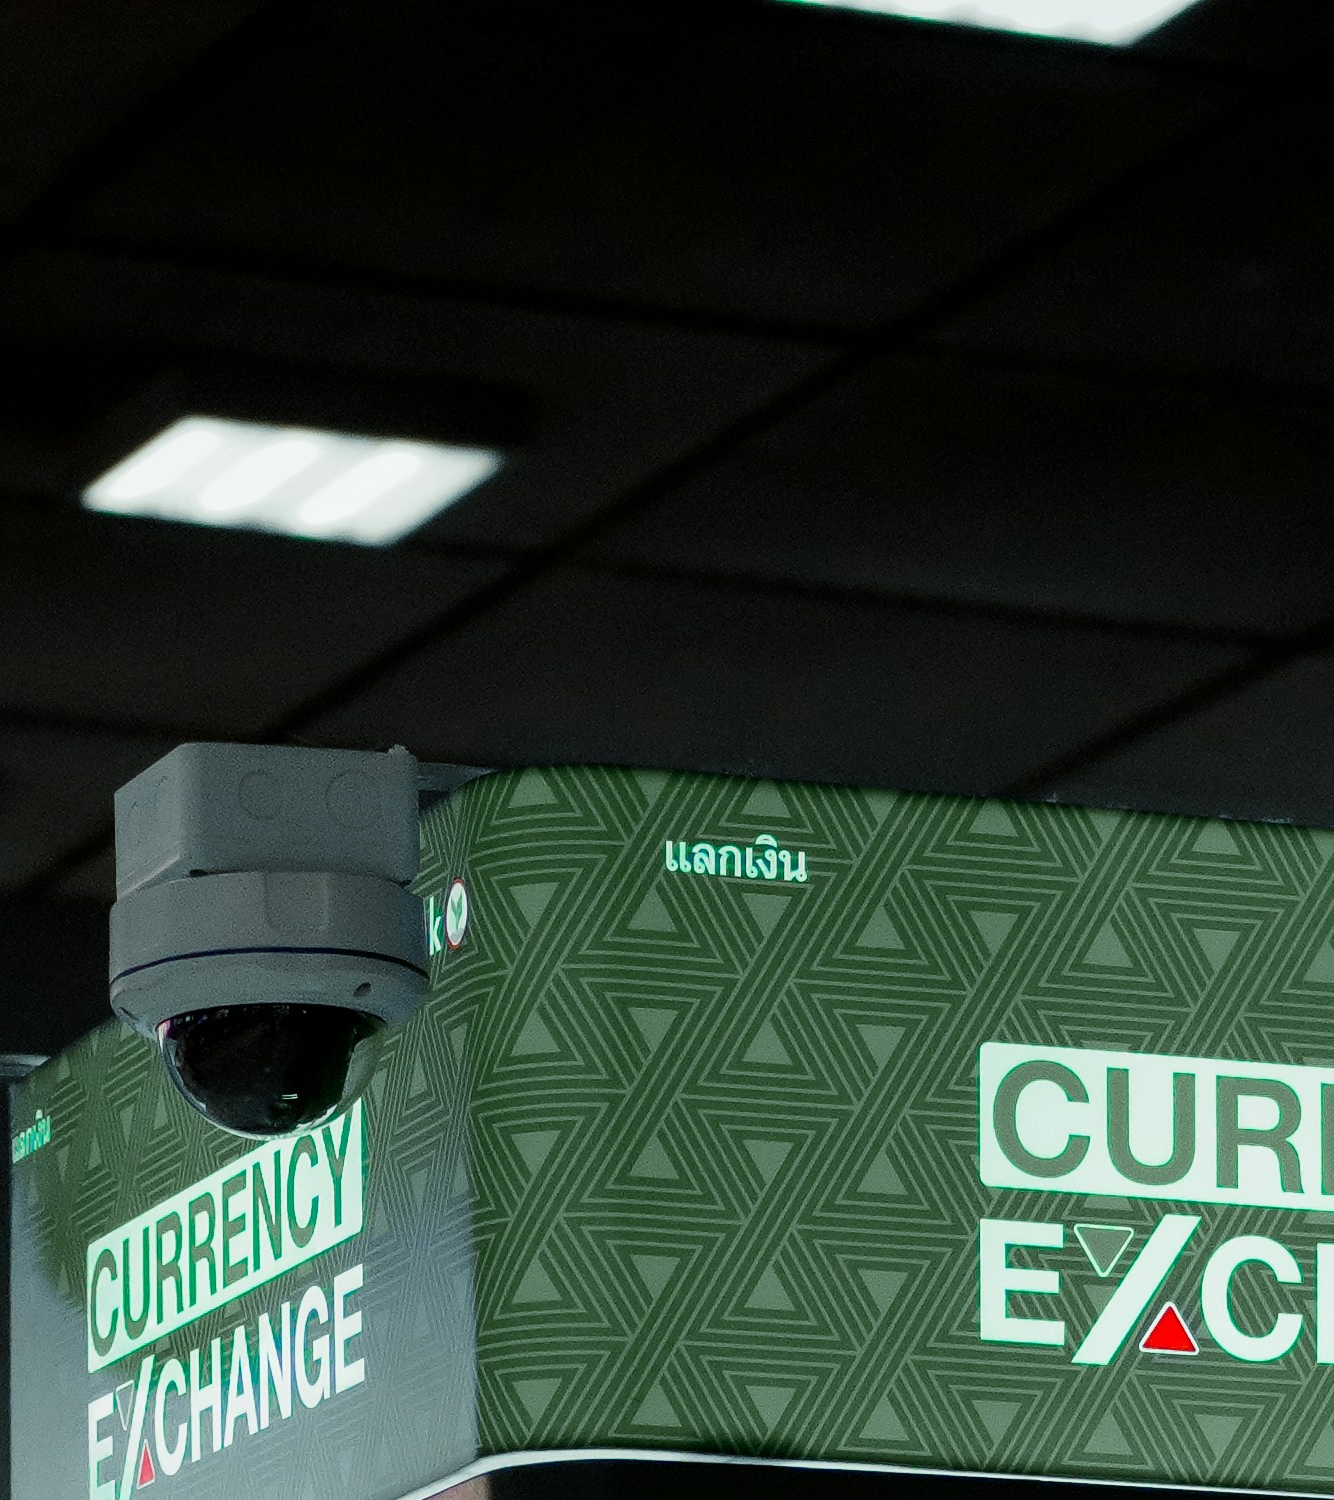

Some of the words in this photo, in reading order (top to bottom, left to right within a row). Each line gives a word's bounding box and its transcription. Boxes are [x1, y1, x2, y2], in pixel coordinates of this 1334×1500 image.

[666, 834, 807, 882] แลกเงิน
[89, 1112, 357, 1358] CURRENCY
